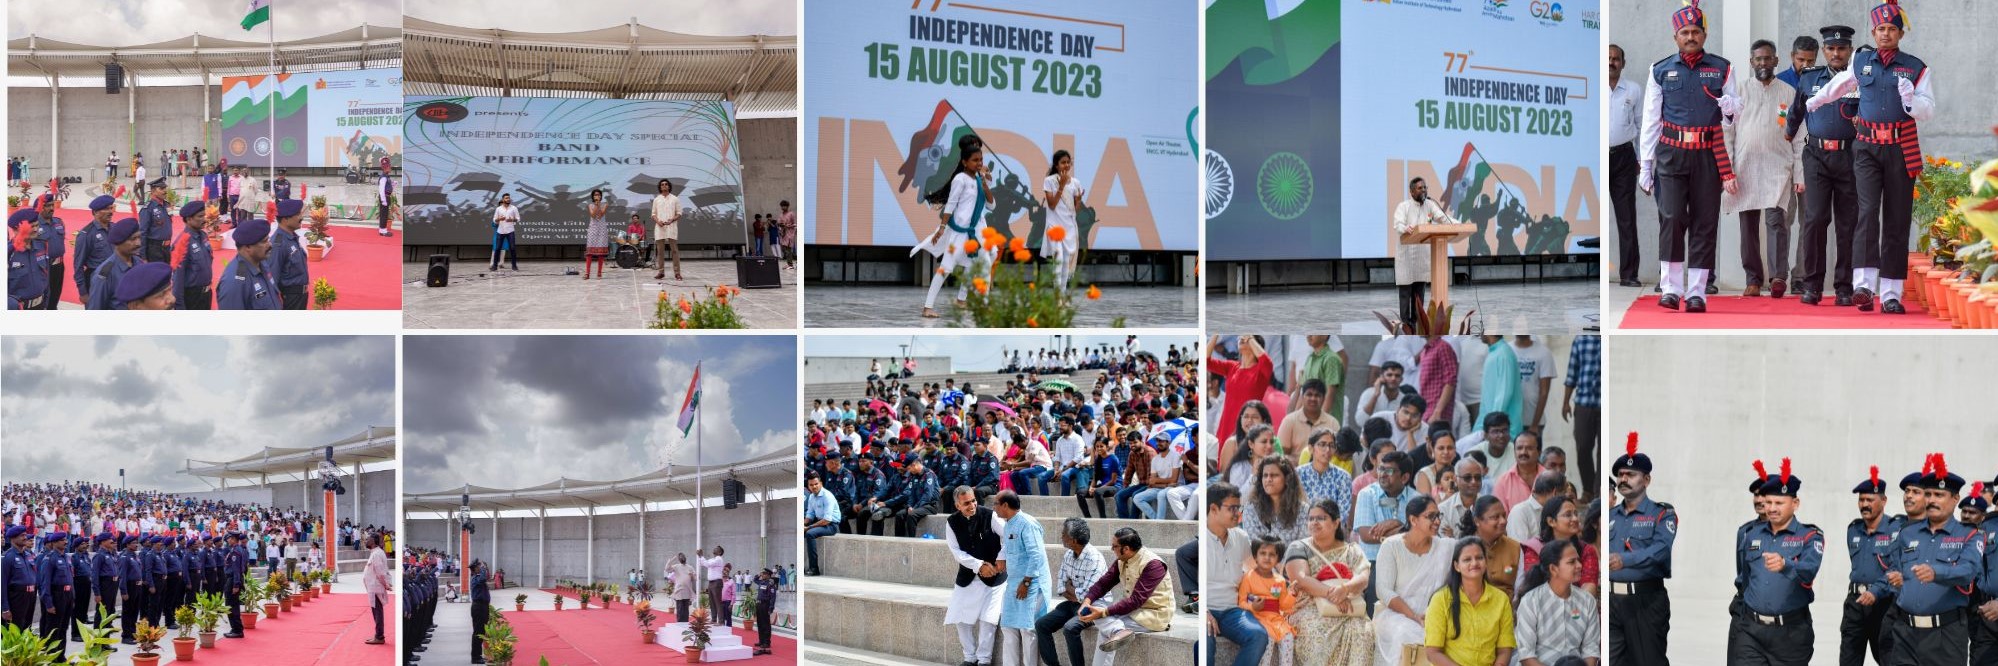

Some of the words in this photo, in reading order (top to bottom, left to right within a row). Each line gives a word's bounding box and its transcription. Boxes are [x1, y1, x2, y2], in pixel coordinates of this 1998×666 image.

[1530, 1, 1564, 22] G20
[909, 15, 1053, 54] INDEPENDENCE
[1060, 32, 1094, 59] DAY
[864, 42, 900, 80] 15
[907, 46, 1025, 91] AUGUST
[1032, 59, 1102, 98] 2023
[1444, 77, 1540, 103] INDEPENDENCE
[1545, 86, 1568, 105] DAY
[348, 107, 393, 115] INDEPENDENCE
[1415, 99, 1439, 129] 15
[1444, 101, 1522, 133] AUGUST
[1526, 107, 1573, 137] 2023
[336, 117, 347, 126] 15
[347, 116, 385, 126] AUGUST
[439, 130, 581, 139] INDEPENDENCE
[538, 143, 600, 152] BAND
[484, 155, 651, 165] PERFORMANCE
